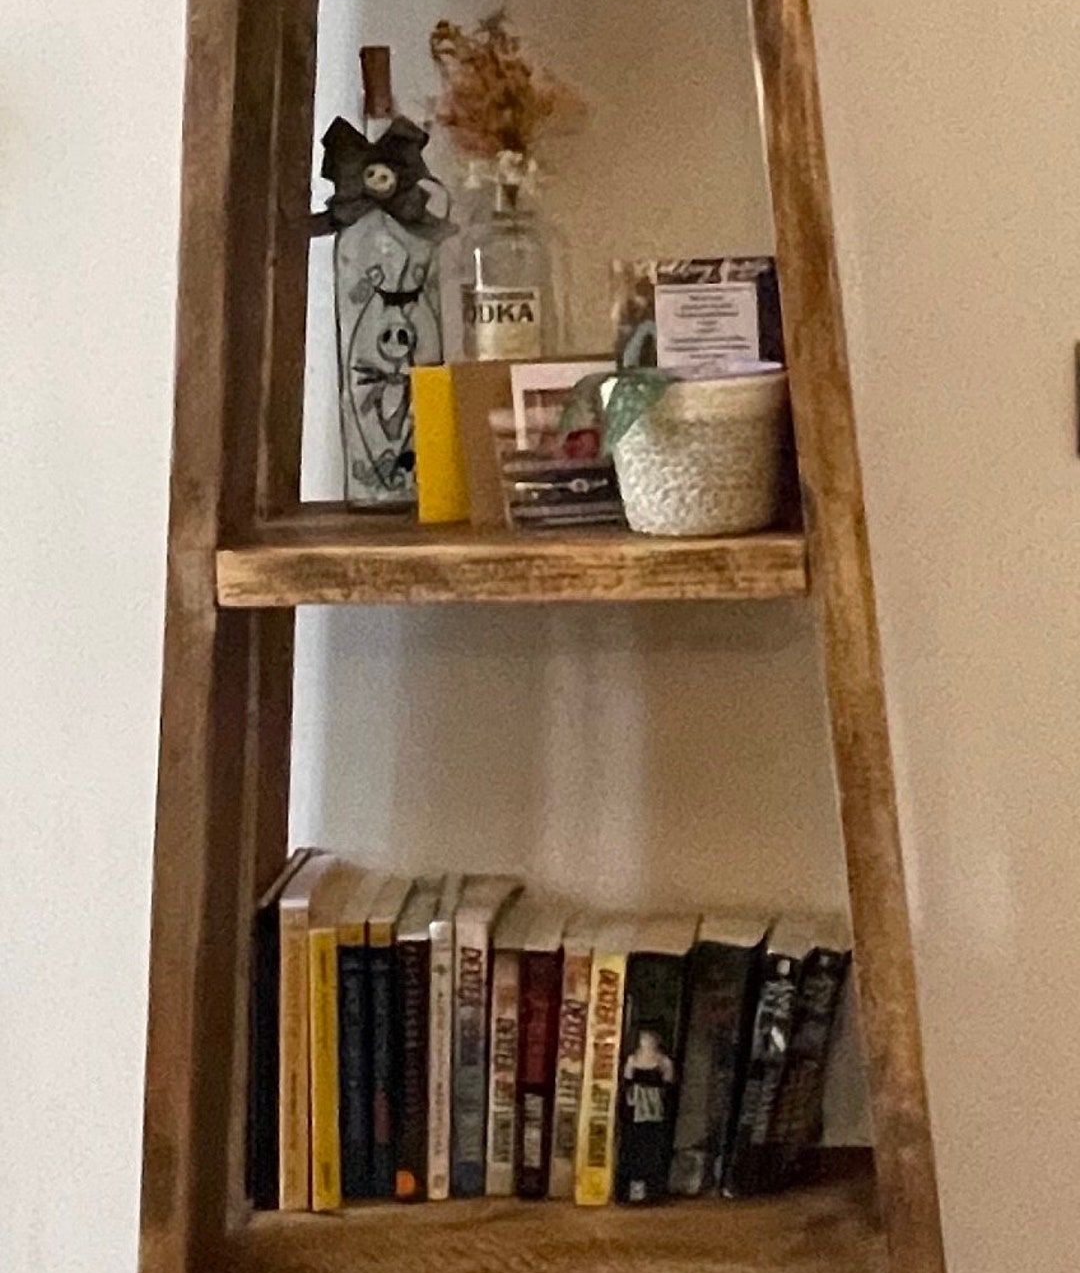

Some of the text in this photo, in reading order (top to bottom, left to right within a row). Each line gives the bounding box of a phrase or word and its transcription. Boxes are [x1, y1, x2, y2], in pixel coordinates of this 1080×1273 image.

[459, 946, 482, 1007] DEXTER
[597, 968, 620, 1025] DEXTER
[494, 1017, 515, 1073] DEXTER
[558, 998, 587, 1062] DEXTER
